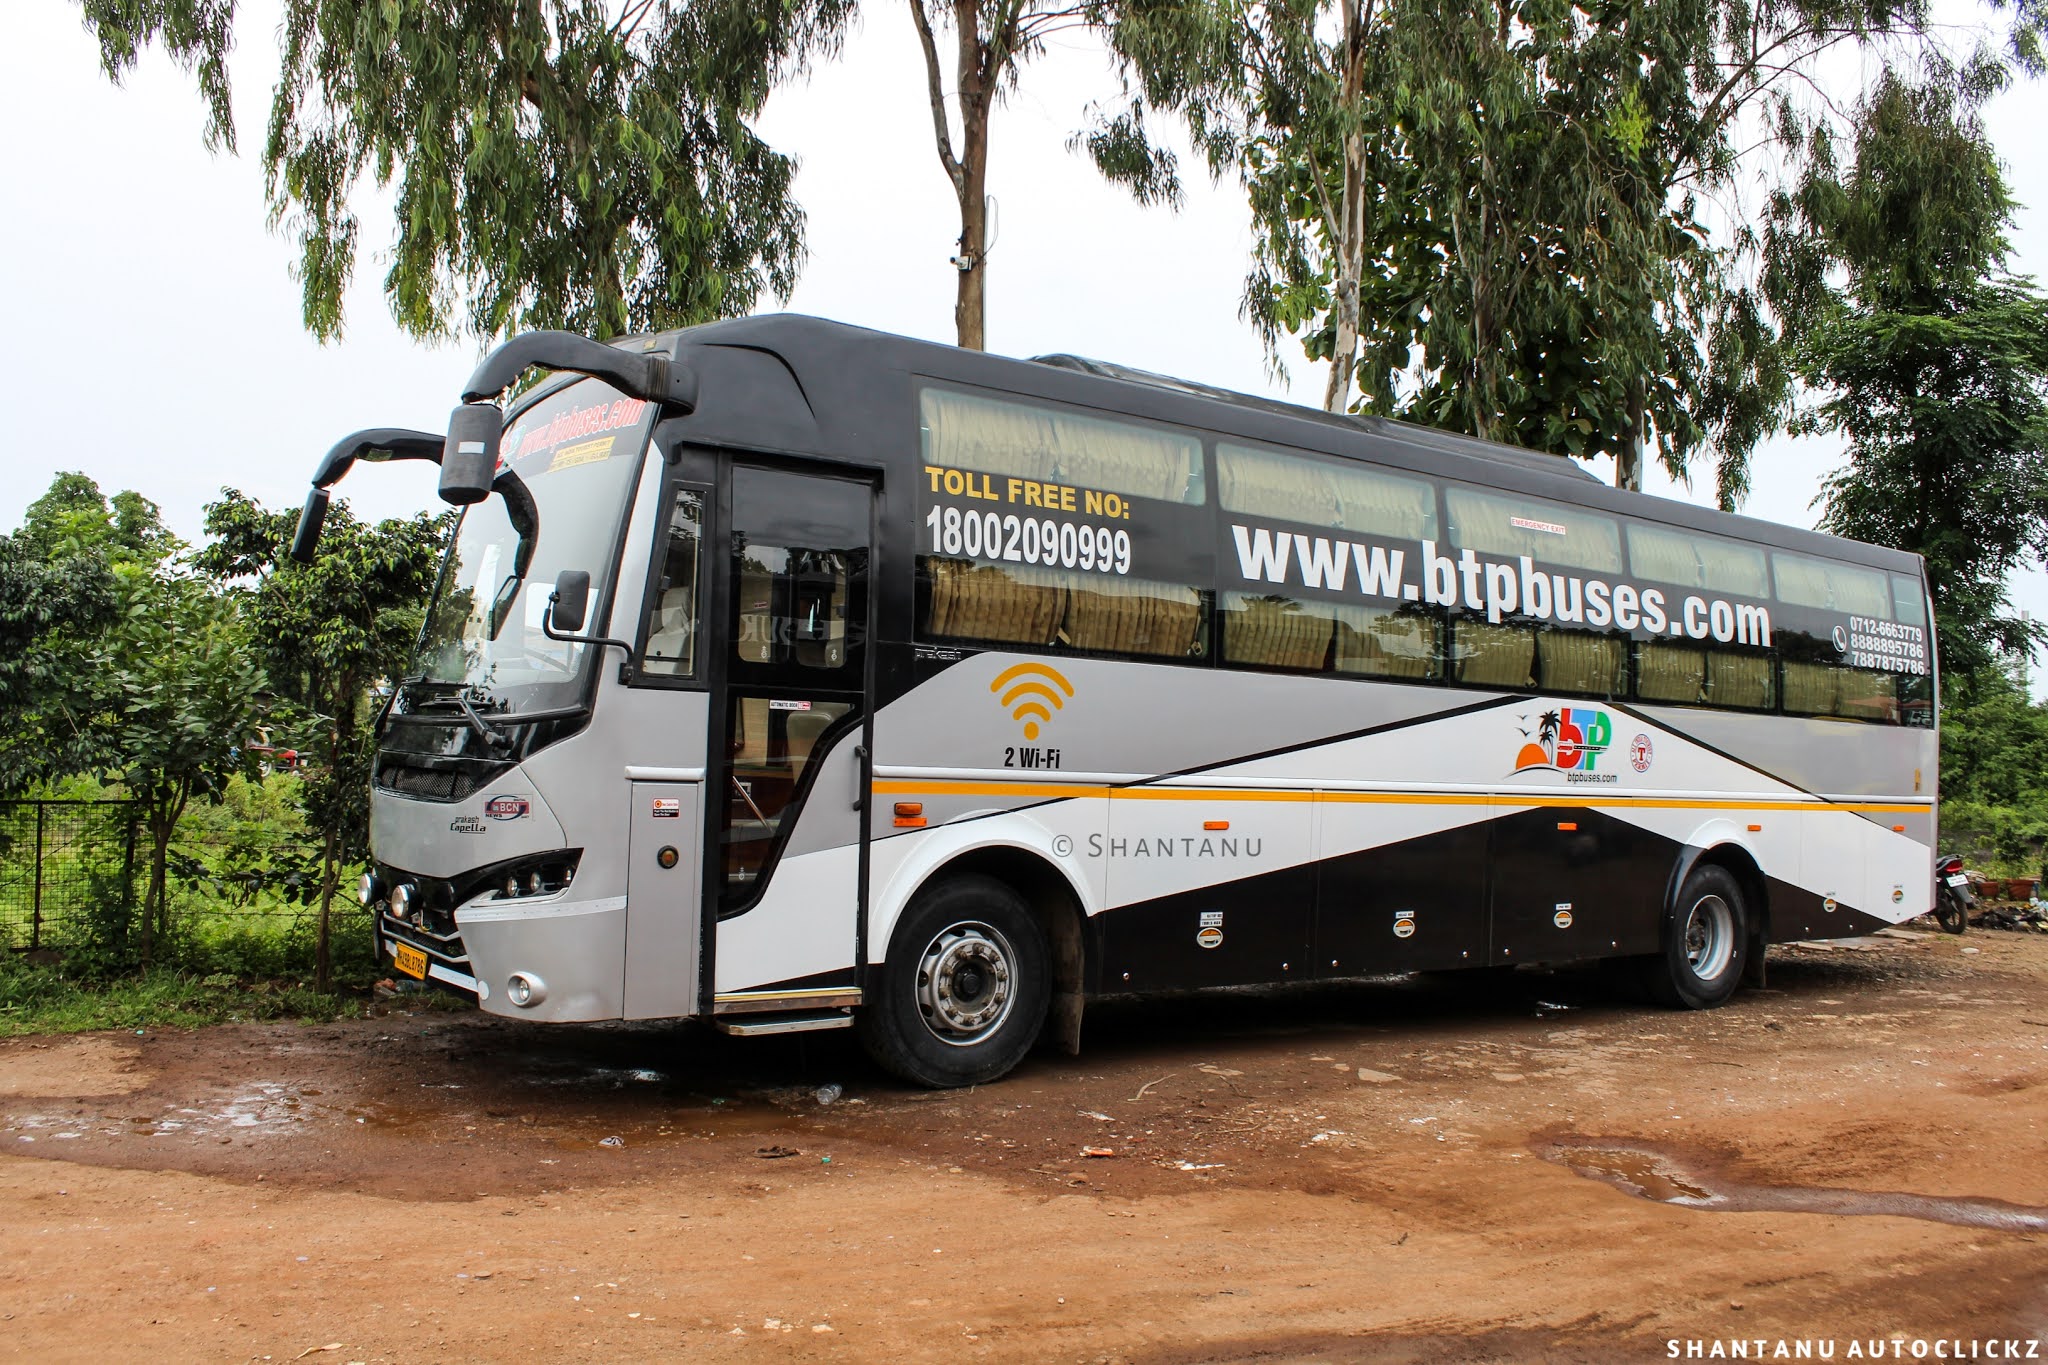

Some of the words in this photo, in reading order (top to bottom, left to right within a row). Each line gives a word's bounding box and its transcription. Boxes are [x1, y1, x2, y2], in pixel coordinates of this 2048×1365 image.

[924, 466, 999, 501] TOLL
[1008, 478, 1077, 512] FREE
[1085, 490, 1130, 520] NO:
[1511, 518, 1549, 531] EMERGENCY
[1551, 525, 1565, 533] EXIT
[926, 504, 1131, 575] 18002090999
[1231, 524, 1771, 648] www.btpbuses.com
[1850, 616, 1923, 642] 0712-6663779
[1850, 633, 1924, 658] 8888895786
[1851, 651, 1925, 676] 7887875786
[1004, 747, 1015, 768] 2
[1019, 747, 1061, 769] Wi-Fi
[1567, 772, 1618, 784] btpbuses.com
[500, 803, 519, 812] BCN
[450, 822, 486, 833] Capella
